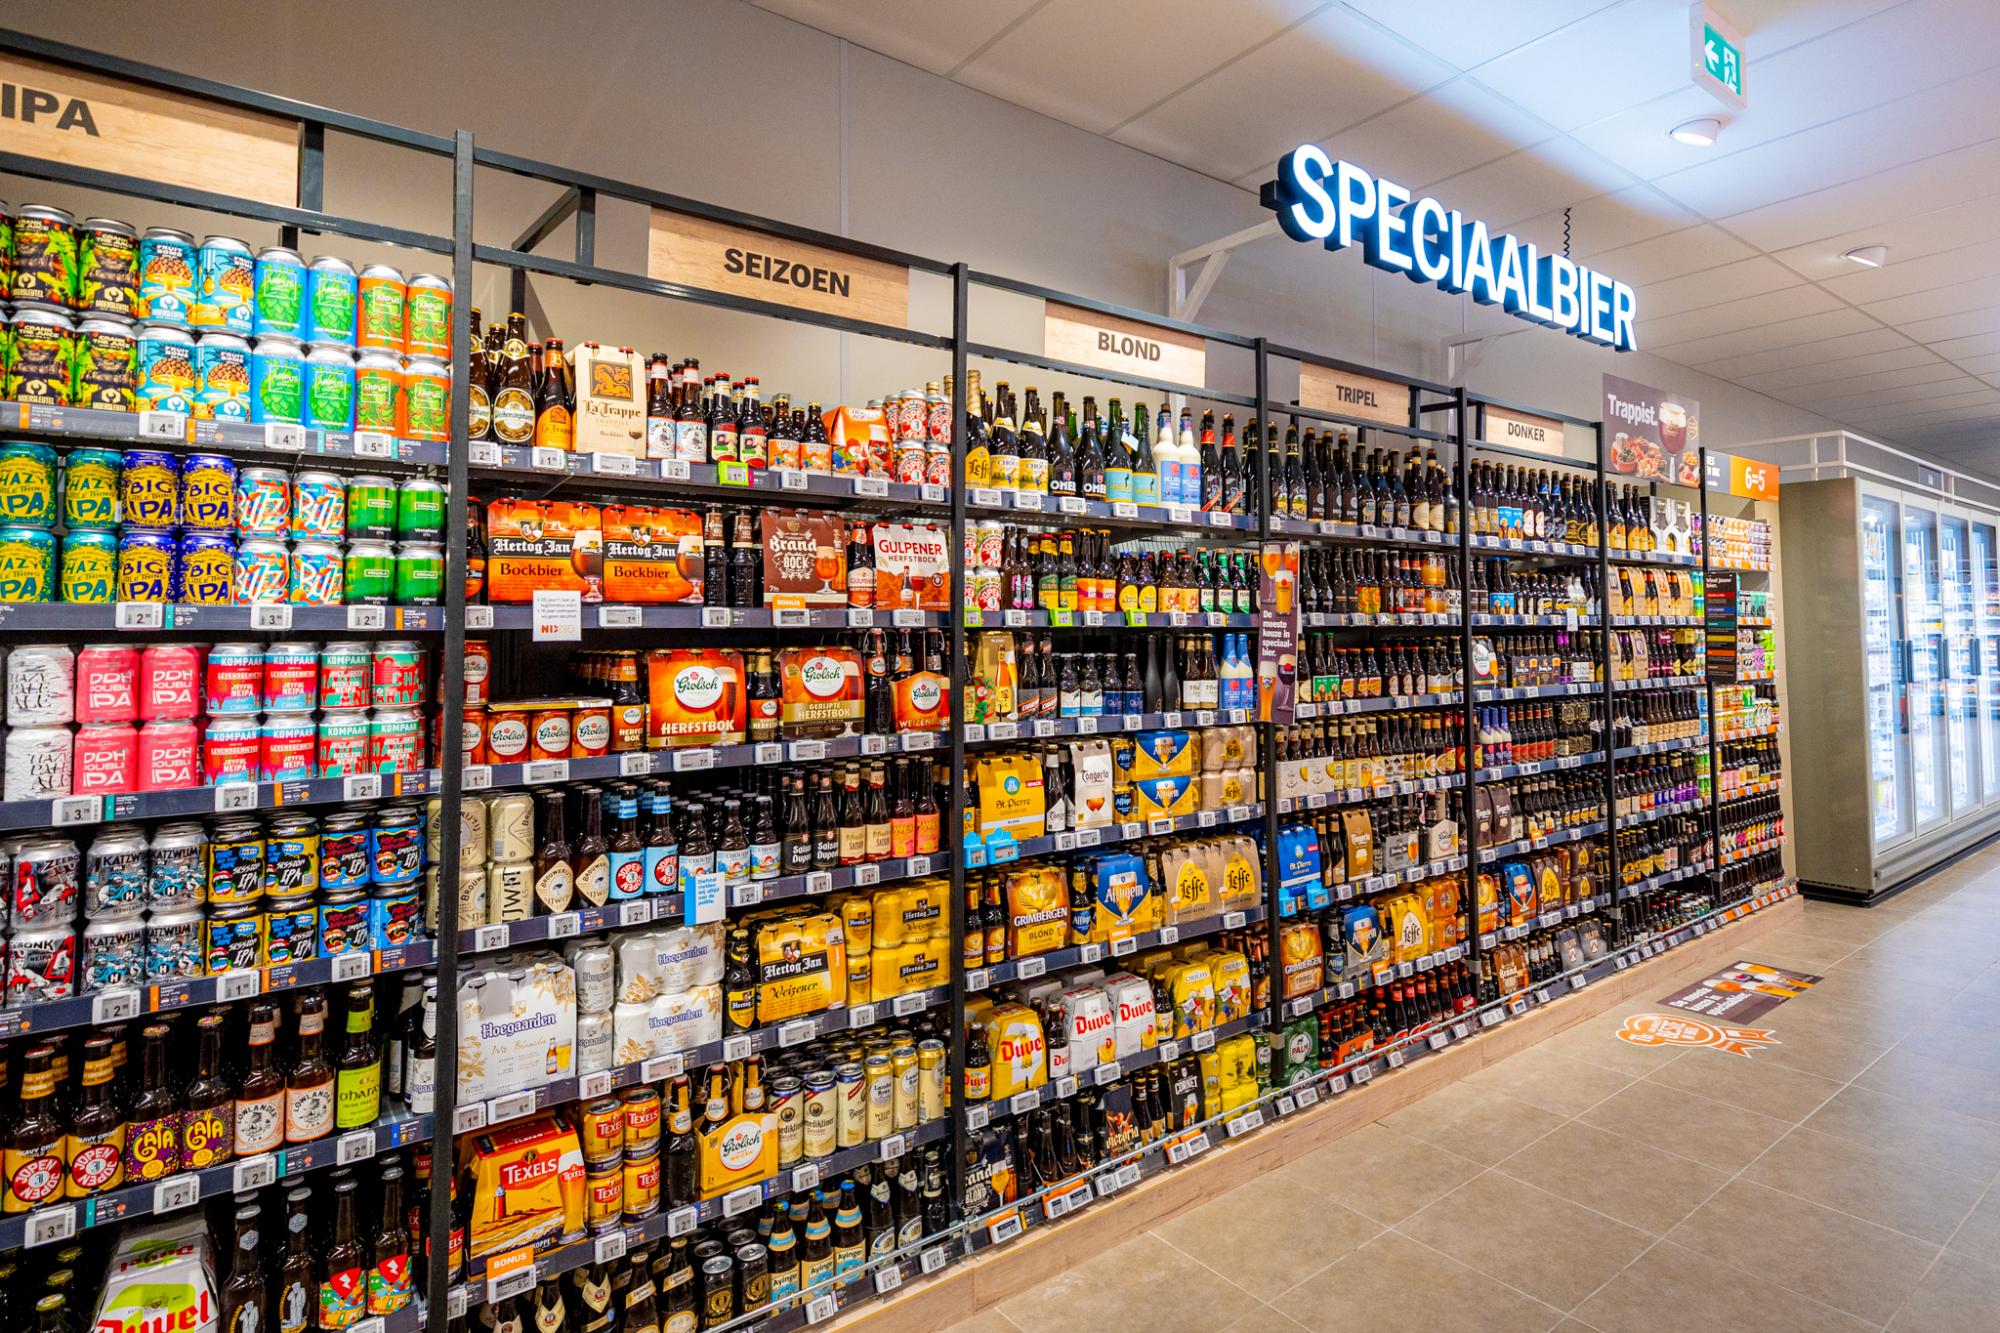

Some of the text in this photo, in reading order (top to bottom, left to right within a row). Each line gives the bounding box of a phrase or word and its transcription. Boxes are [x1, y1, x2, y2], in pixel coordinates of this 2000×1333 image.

[2, 84, 100, 137] IPA
[156, 244, 183, 252] FRUIT
[1291, 144, 1637, 351] SPECIAALBIER
[724, 248, 850, 297] SEIZOEN
[1098, 331, 1161, 362] BLOND
[1336, 385, 1378, 408] TRIPEL
[584, 400, 641, 419] La Trappe
[1608, 394, 1658, 426] Trappist.
[1508, 422, 1545, 442] DONKER
[68, 478, 113, 490] HAZY
[1745, 466, 1766, 491] 6=5
[131, 480, 172, 494] BIG
[190, 482, 229, 496] BIG
[69, 498, 112, 516] IPA
[130, 499, 172, 519] IPA
[189, 501, 229, 520] IPA
[493, 539, 570, 556] Hertog Jan
[608, 542, 675, 559] Hertog Jan
[769, 538, 817, 551] Brand
[879, 540, 942, 555] GULPENER
[64, 560, 108, 573] HAZY
[784, 556, 808, 569] BOCK
[889, 556, 937, 564] HERFSTBOCK
[123, 561, 163, 575] BIG
[190, 563, 231, 577] BIG
[501, 563, 564, 577] Bockbier
[614, 566, 670, 579] Bockbier
[64, 579, 107, 599] IPA
[119, 580, 162, 600] IPA
[189, 583, 228, 600] IPA
[1263, 610, 1272, 618] De
[1263, 620, 1287, 629] meeste
[1263, 629, 1290, 638] keuze in
[221, 657, 262, 666] KOMPAAN
[273, 656, 314, 664] KOMPAAN
[327, 656, 366, 664] KOMPAAN
[90, 673, 131, 684] DDH
[153, 670, 193, 683] DDH
[804, 665, 841, 682] Grolsch
[677, 676, 719, 692] Grolsch
[90, 694, 131, 707] IPA
[153, 690, 191, 704] IPA
[912, 687, 938, 700] Grolsch
[810, 702, 840, 710] GERIJPTE
[799, 709, 850, 719] HERFSTBOK
[273, 729, 314, 738] KOMPAAN
[328, 727, 367, 736] KOMPAAN
[381, 723, 417, 732] KOMPAAN
[661, 719, 734, 734] HERFSTBOK
[214, 733, 256, 741] KOMPAAN
[491, 728, 525, 743] Grolsch
[84, 751, 125, 763] DDH
[152, 749, 192, 762] DDH
[152, 768, 190, 783] IPA
[223, 764, 246, 772] NEIPA
[83, 773, 124, 787] IPA
[1080, 769, 1110, 783] Tongerlo
[1010, 797, 1031, 809] Pierre
[233, 863, 260, 874] SESSION
[277, 859, 306, 869] SESSION
[1228, 867, 1250, 889] Leffe
[1179, 880, 1204, 900] Leffe
[904, 907, 940, 921] Hertog Jan
[1014, 908, 1068, 927] GRIMBERGEN
[1029, 927, 1054, 941] BLOND
[1403, 925, 1422, 944] Leffe
[229, 938, 257, 950] SESSION
[658, 945, 708, 966] Hoegaarden
[765, 956, 822, 980] Hertog Jan
[901, 961, 937, 974] Hertog Jan
[1285, 957, 1322, 975] GRIMBERGEN
[771, 981, 818, 998] Weizener
[649, 1008, 703, 1028] Hoegaarden
[1120, 1001, 1153, 1021] Duve
[482, 1012, 557, 1039] Hoegaarden
[1075, 1011, 1112, 1035] Duve
[1001, 1036, 1043, 1061] Duvel
[1291, 1045, 1309, 1055] PALM
[1174, 1077, 1198, 1093] CORNET
[236, 1104, 278, 1124] LOWLANDER
[628, 1110, 658, 1125] TEXELS
[186, 1118, 224, 1151] GAIA
[599, 1119, 623, 1135] TEXEL
[133, 1128, 175, 1162] GAIA
[721, 1130, 761, 1156] Grolsch
[74, 1147, 114, 1172] JOPEN
[16, 1157, 57, 1184] JOPEN
[503, 1158, 557, 1185] TEXELS
[562, 1168, 586, 1181] TEXELS
[965, 1166, 993, 1186] rand
[493, 1253, 528, 1269] BONUS
[838, 1249, 862, 1261] Ayinger
[773, 1273, 798, 1288] Ayinger
